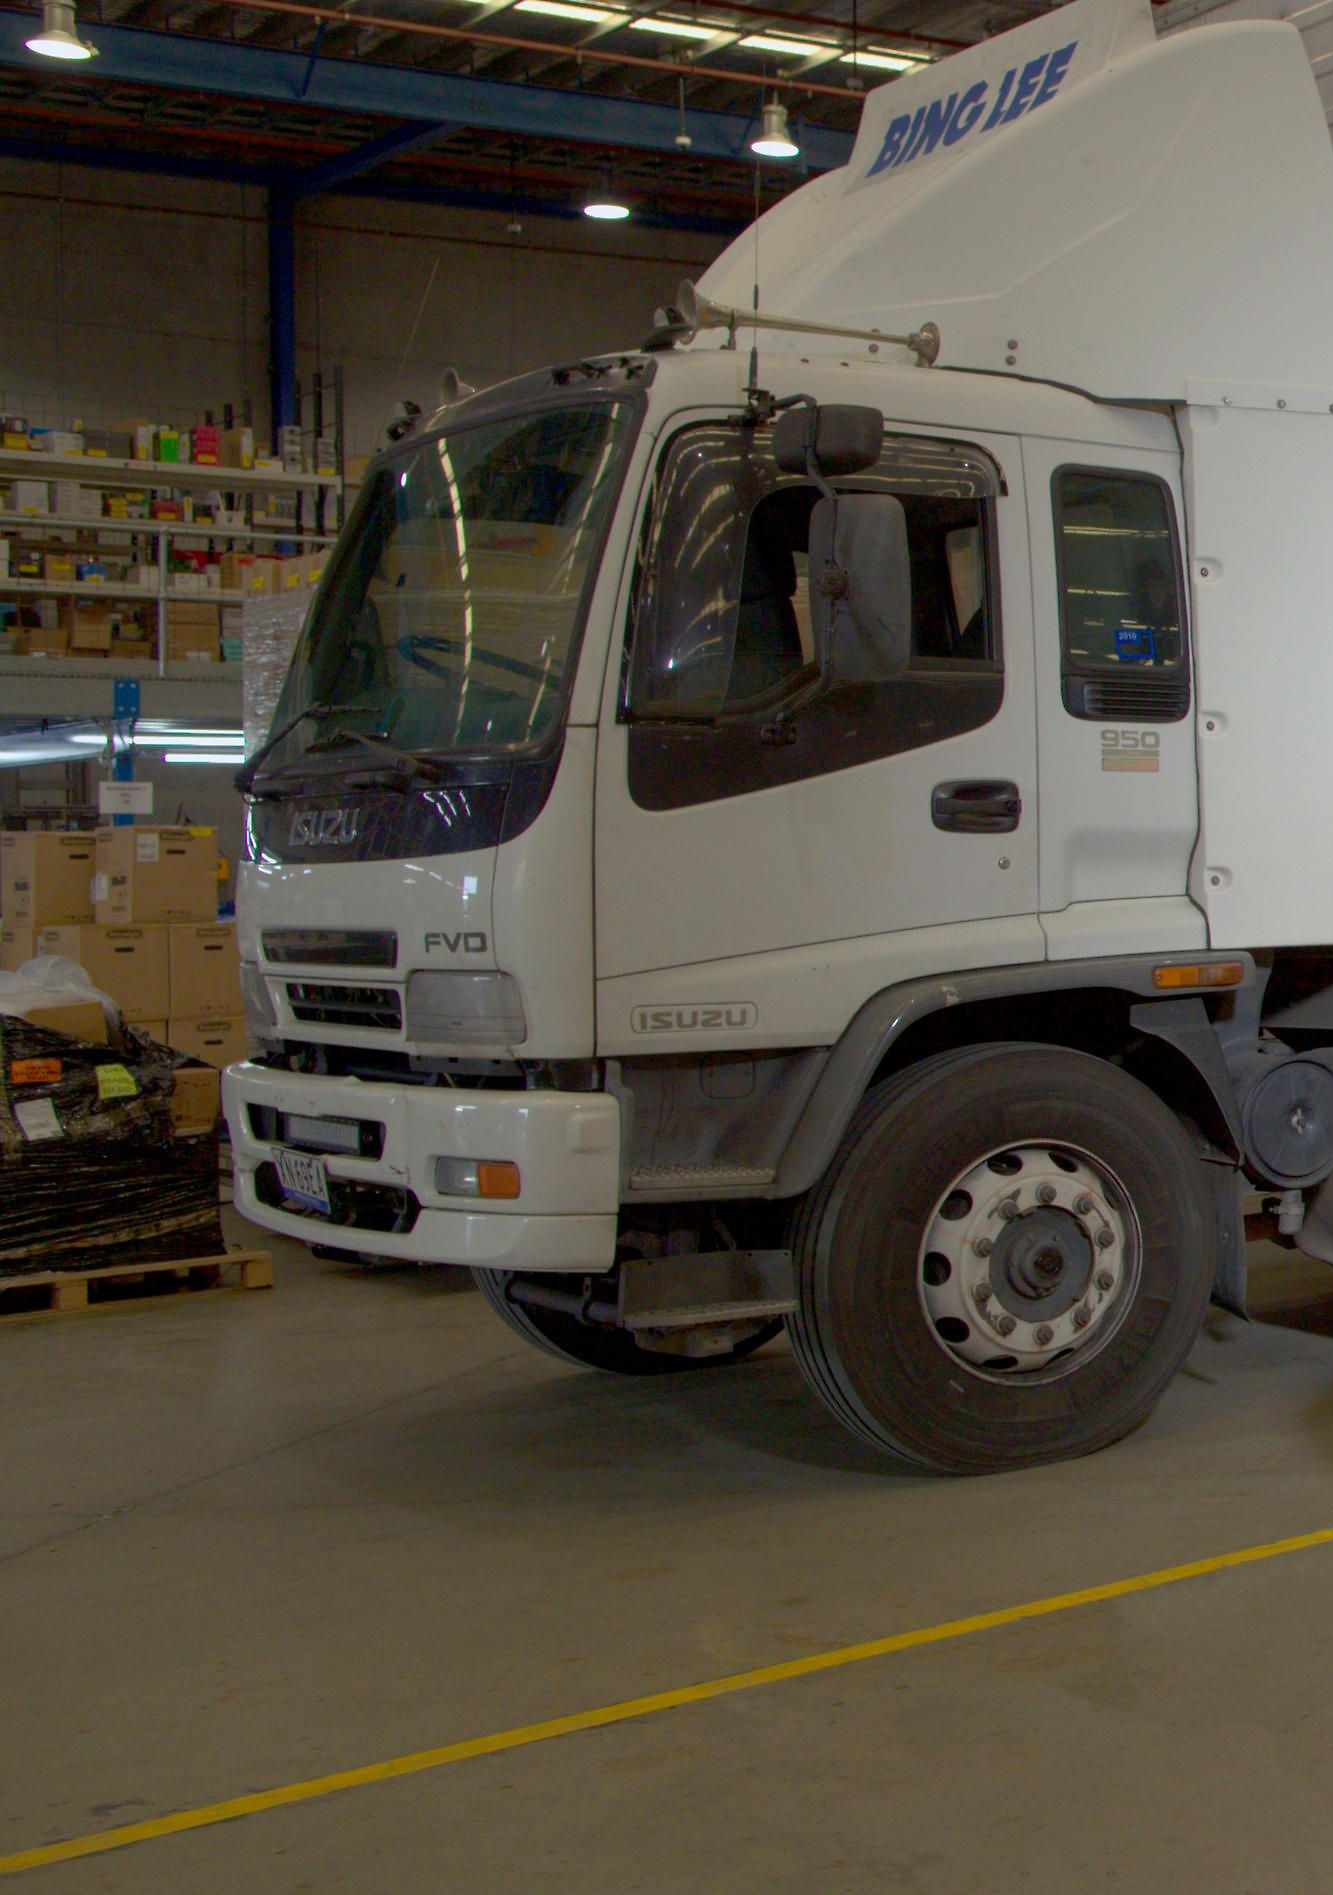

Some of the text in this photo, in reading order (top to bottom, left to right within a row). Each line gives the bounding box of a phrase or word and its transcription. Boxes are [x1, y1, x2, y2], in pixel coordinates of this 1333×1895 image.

[865, 40, 1079, 178] BING LEE
[1101, 729, 1161, 749] 950
[288, 808, 361, 846] ISUZU
[424, 932, 488, 953] FVD
[639, 1008, 747, 1031] ISUZU
